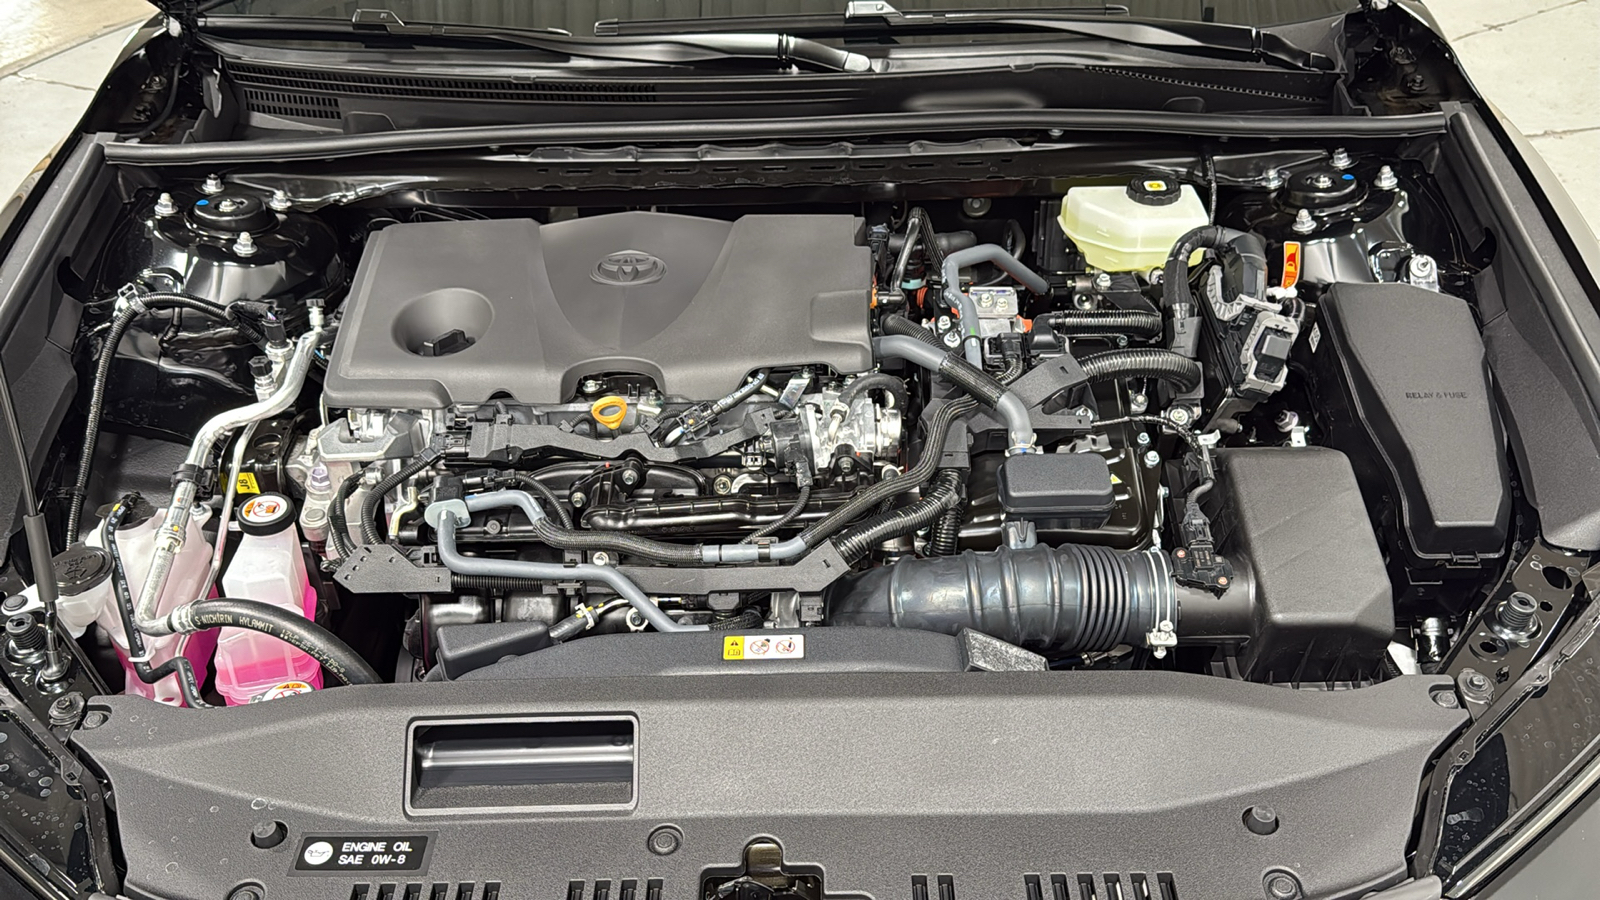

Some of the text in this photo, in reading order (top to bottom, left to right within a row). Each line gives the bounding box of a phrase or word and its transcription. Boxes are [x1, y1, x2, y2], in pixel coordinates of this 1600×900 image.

[341, 841, 413, 852] ENGINE OIL
[338, 854, 406, 865] SAE 0W-8
